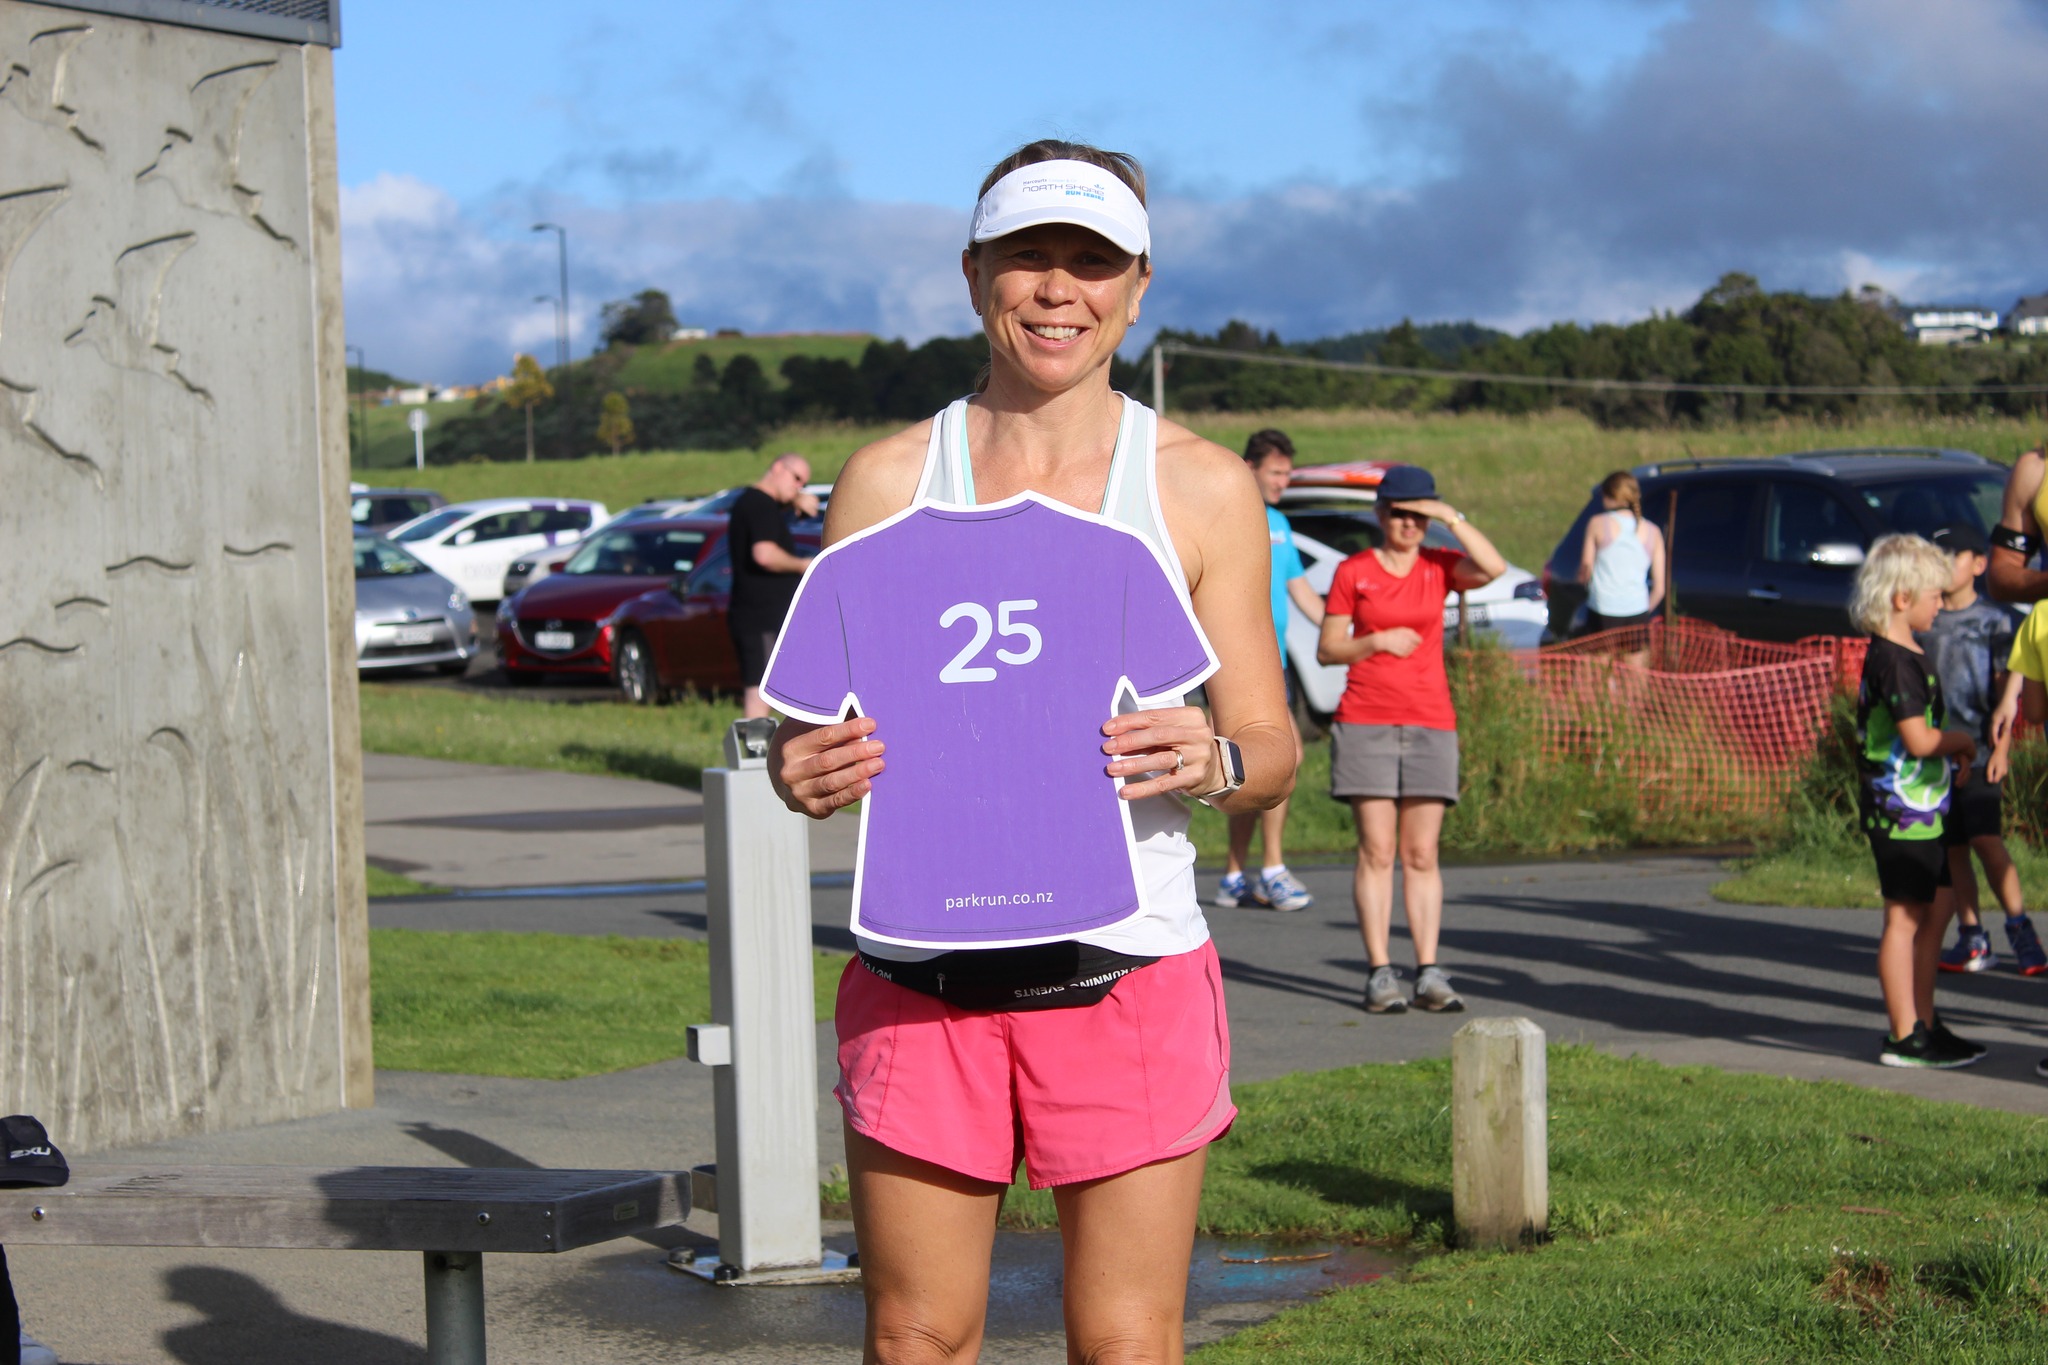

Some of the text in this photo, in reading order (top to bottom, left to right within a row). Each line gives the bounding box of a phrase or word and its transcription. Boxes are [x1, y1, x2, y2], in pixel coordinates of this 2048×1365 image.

[1022, 184, 1104, 195] NORTH SHORE
[938, 599, 1043, 684] 25
[945, 891, 1053, 911] parkrun.co.nz
